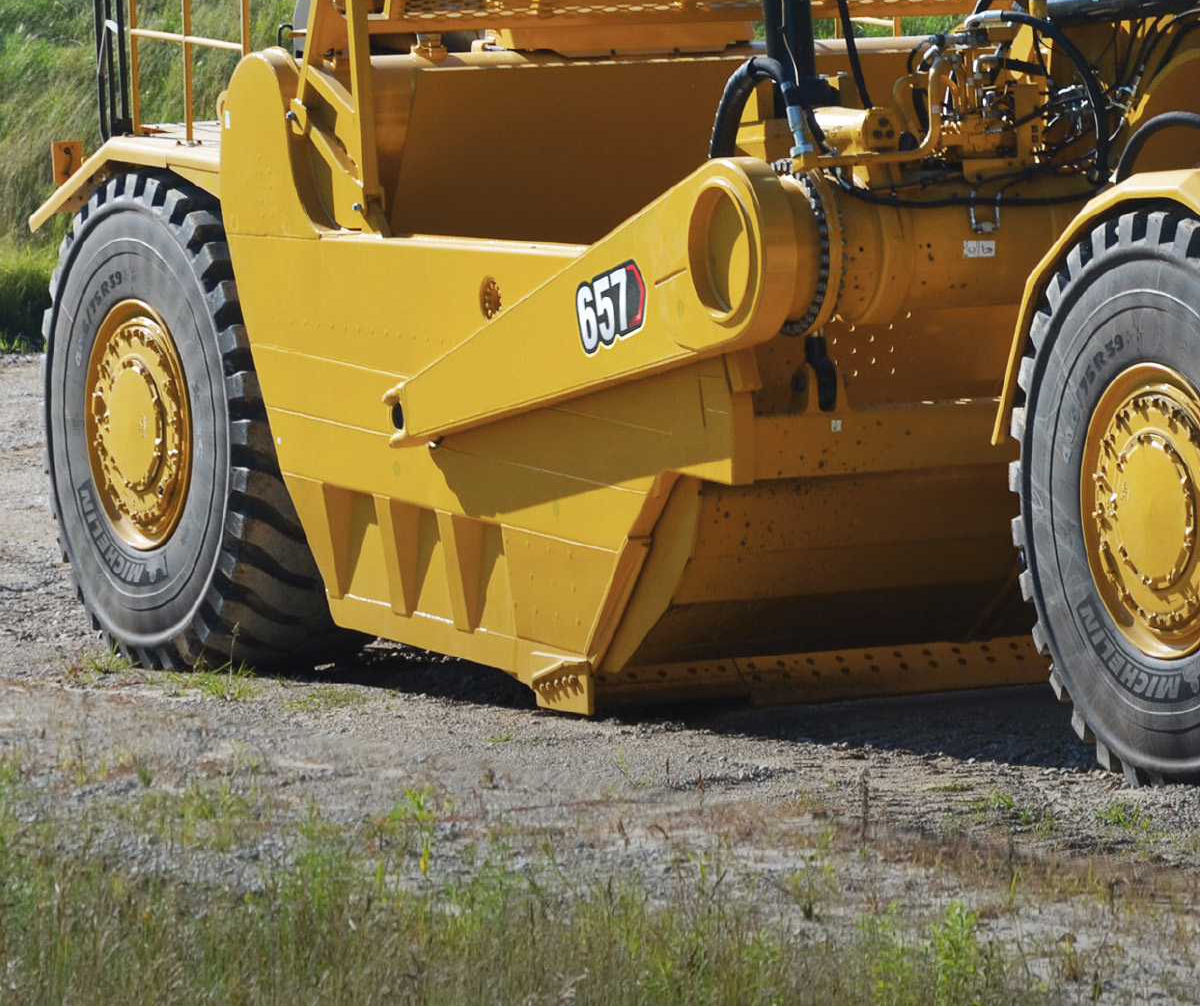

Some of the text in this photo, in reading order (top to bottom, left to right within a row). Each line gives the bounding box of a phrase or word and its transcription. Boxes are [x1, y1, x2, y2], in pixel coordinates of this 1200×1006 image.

[577, 267, 628, 350] 657
[80, 489, 145, 583] MICHELIN
[1078, 606, 1181, 699] MICHELIN
